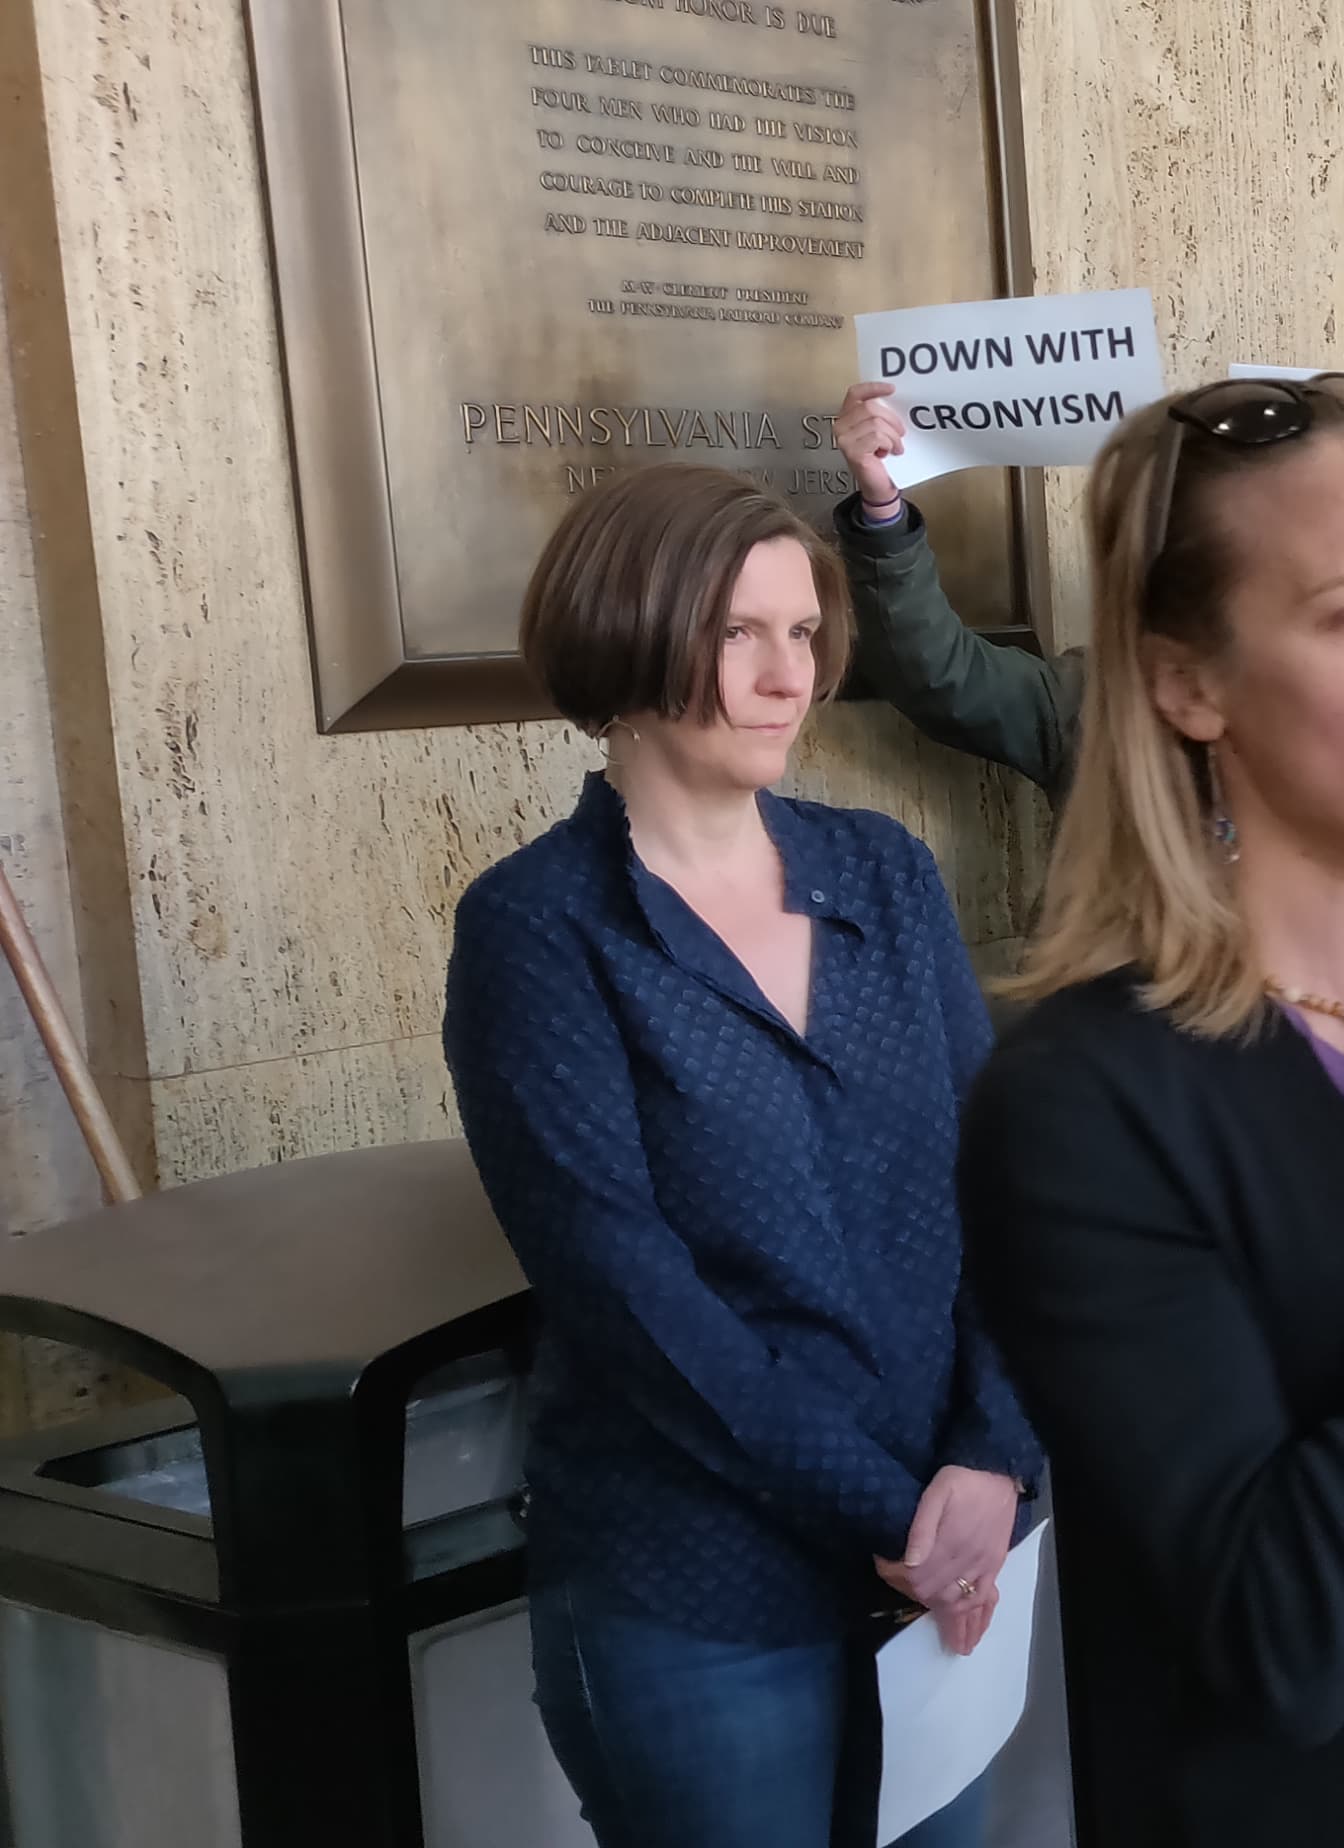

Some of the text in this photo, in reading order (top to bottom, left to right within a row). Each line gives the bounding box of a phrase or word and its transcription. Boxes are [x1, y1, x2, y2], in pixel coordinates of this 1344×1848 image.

[765, 6, 785, 29] IS
[797, 11, 837, 38] DUE
[529, 45, 855, 111] THIS TABLET COMMEMORATES THE
[530, 88, 858, 148] FOUR MEN WHO HAD THE VISION
[537, 129, 860, 185] TO CONCEIVE AND THE WILL AND
[540, 171, 863, 223] COURAGE TO COMPLETE THIS STATION
[545, 213, 864, 259] AND THE ADJACENT IMPROVEMENT
[621, 302, 715, 321] PENNSYLVANIA
[880, 326, 1134, 378] DOWN WITH
[460, 402, 782, 449] PENNSYLVANIA
[910, 391, 1124, 430] CRONYISM
